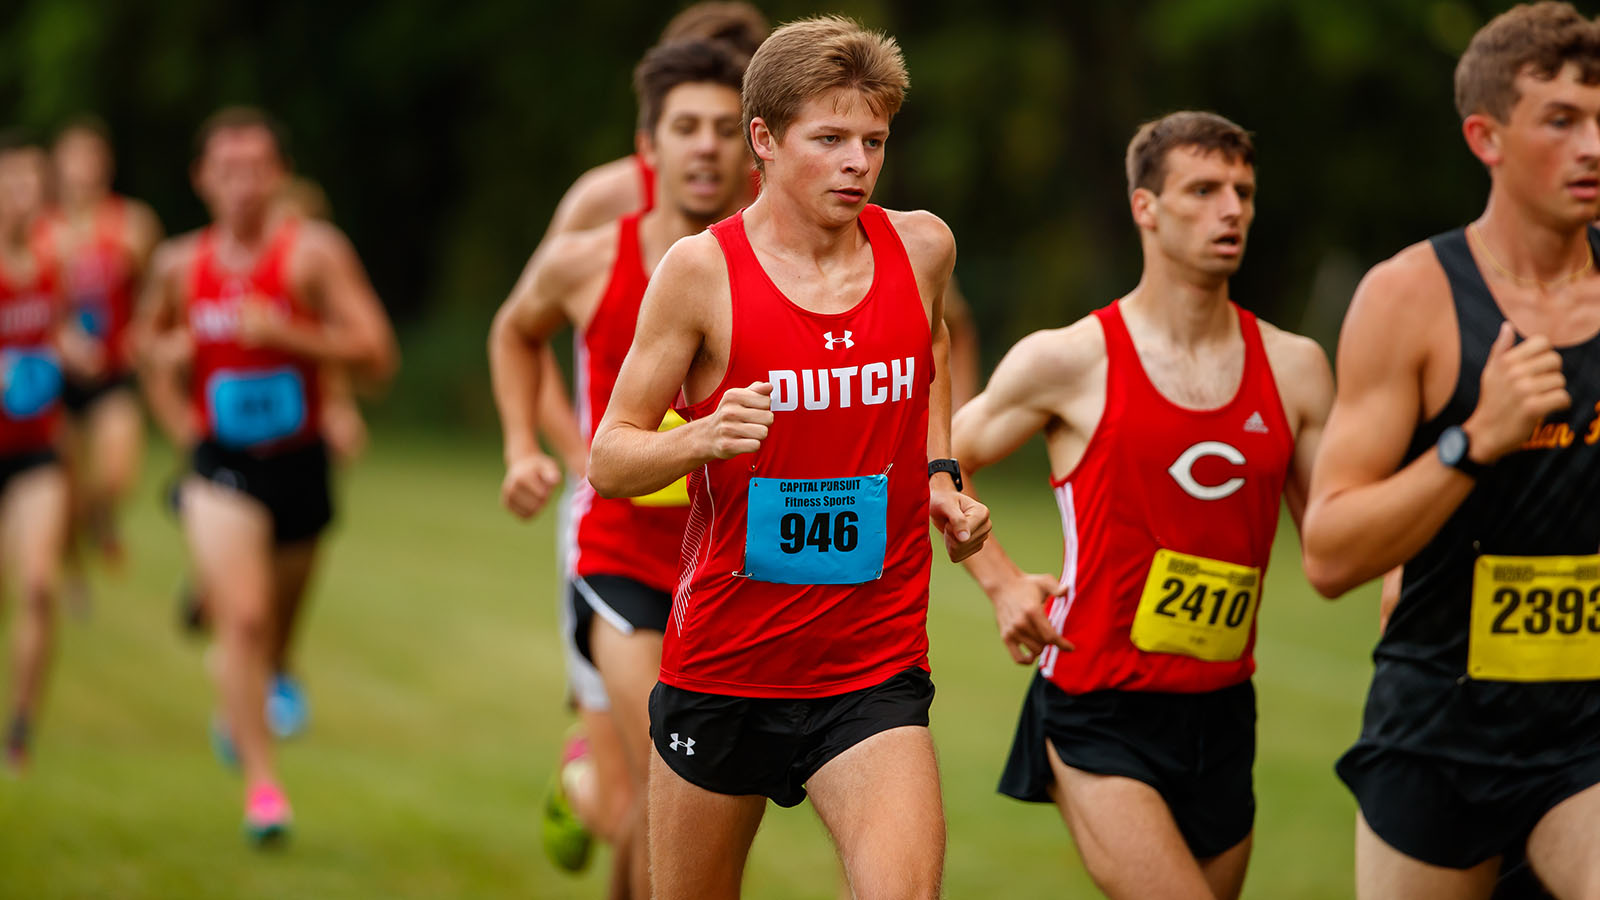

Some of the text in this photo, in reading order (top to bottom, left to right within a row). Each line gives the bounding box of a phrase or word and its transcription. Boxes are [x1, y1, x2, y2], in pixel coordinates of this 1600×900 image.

[769, 356, 915, 411] DUTCH
[780, 479, 860, 493] CAPITAL PURSUIT
[1168, 441, 1246, 501] C
[785, 495, 856, 507] Fitness Sports
[780, 510, 859, 554] 946
[1155, 578, 1250, 628] 2410
